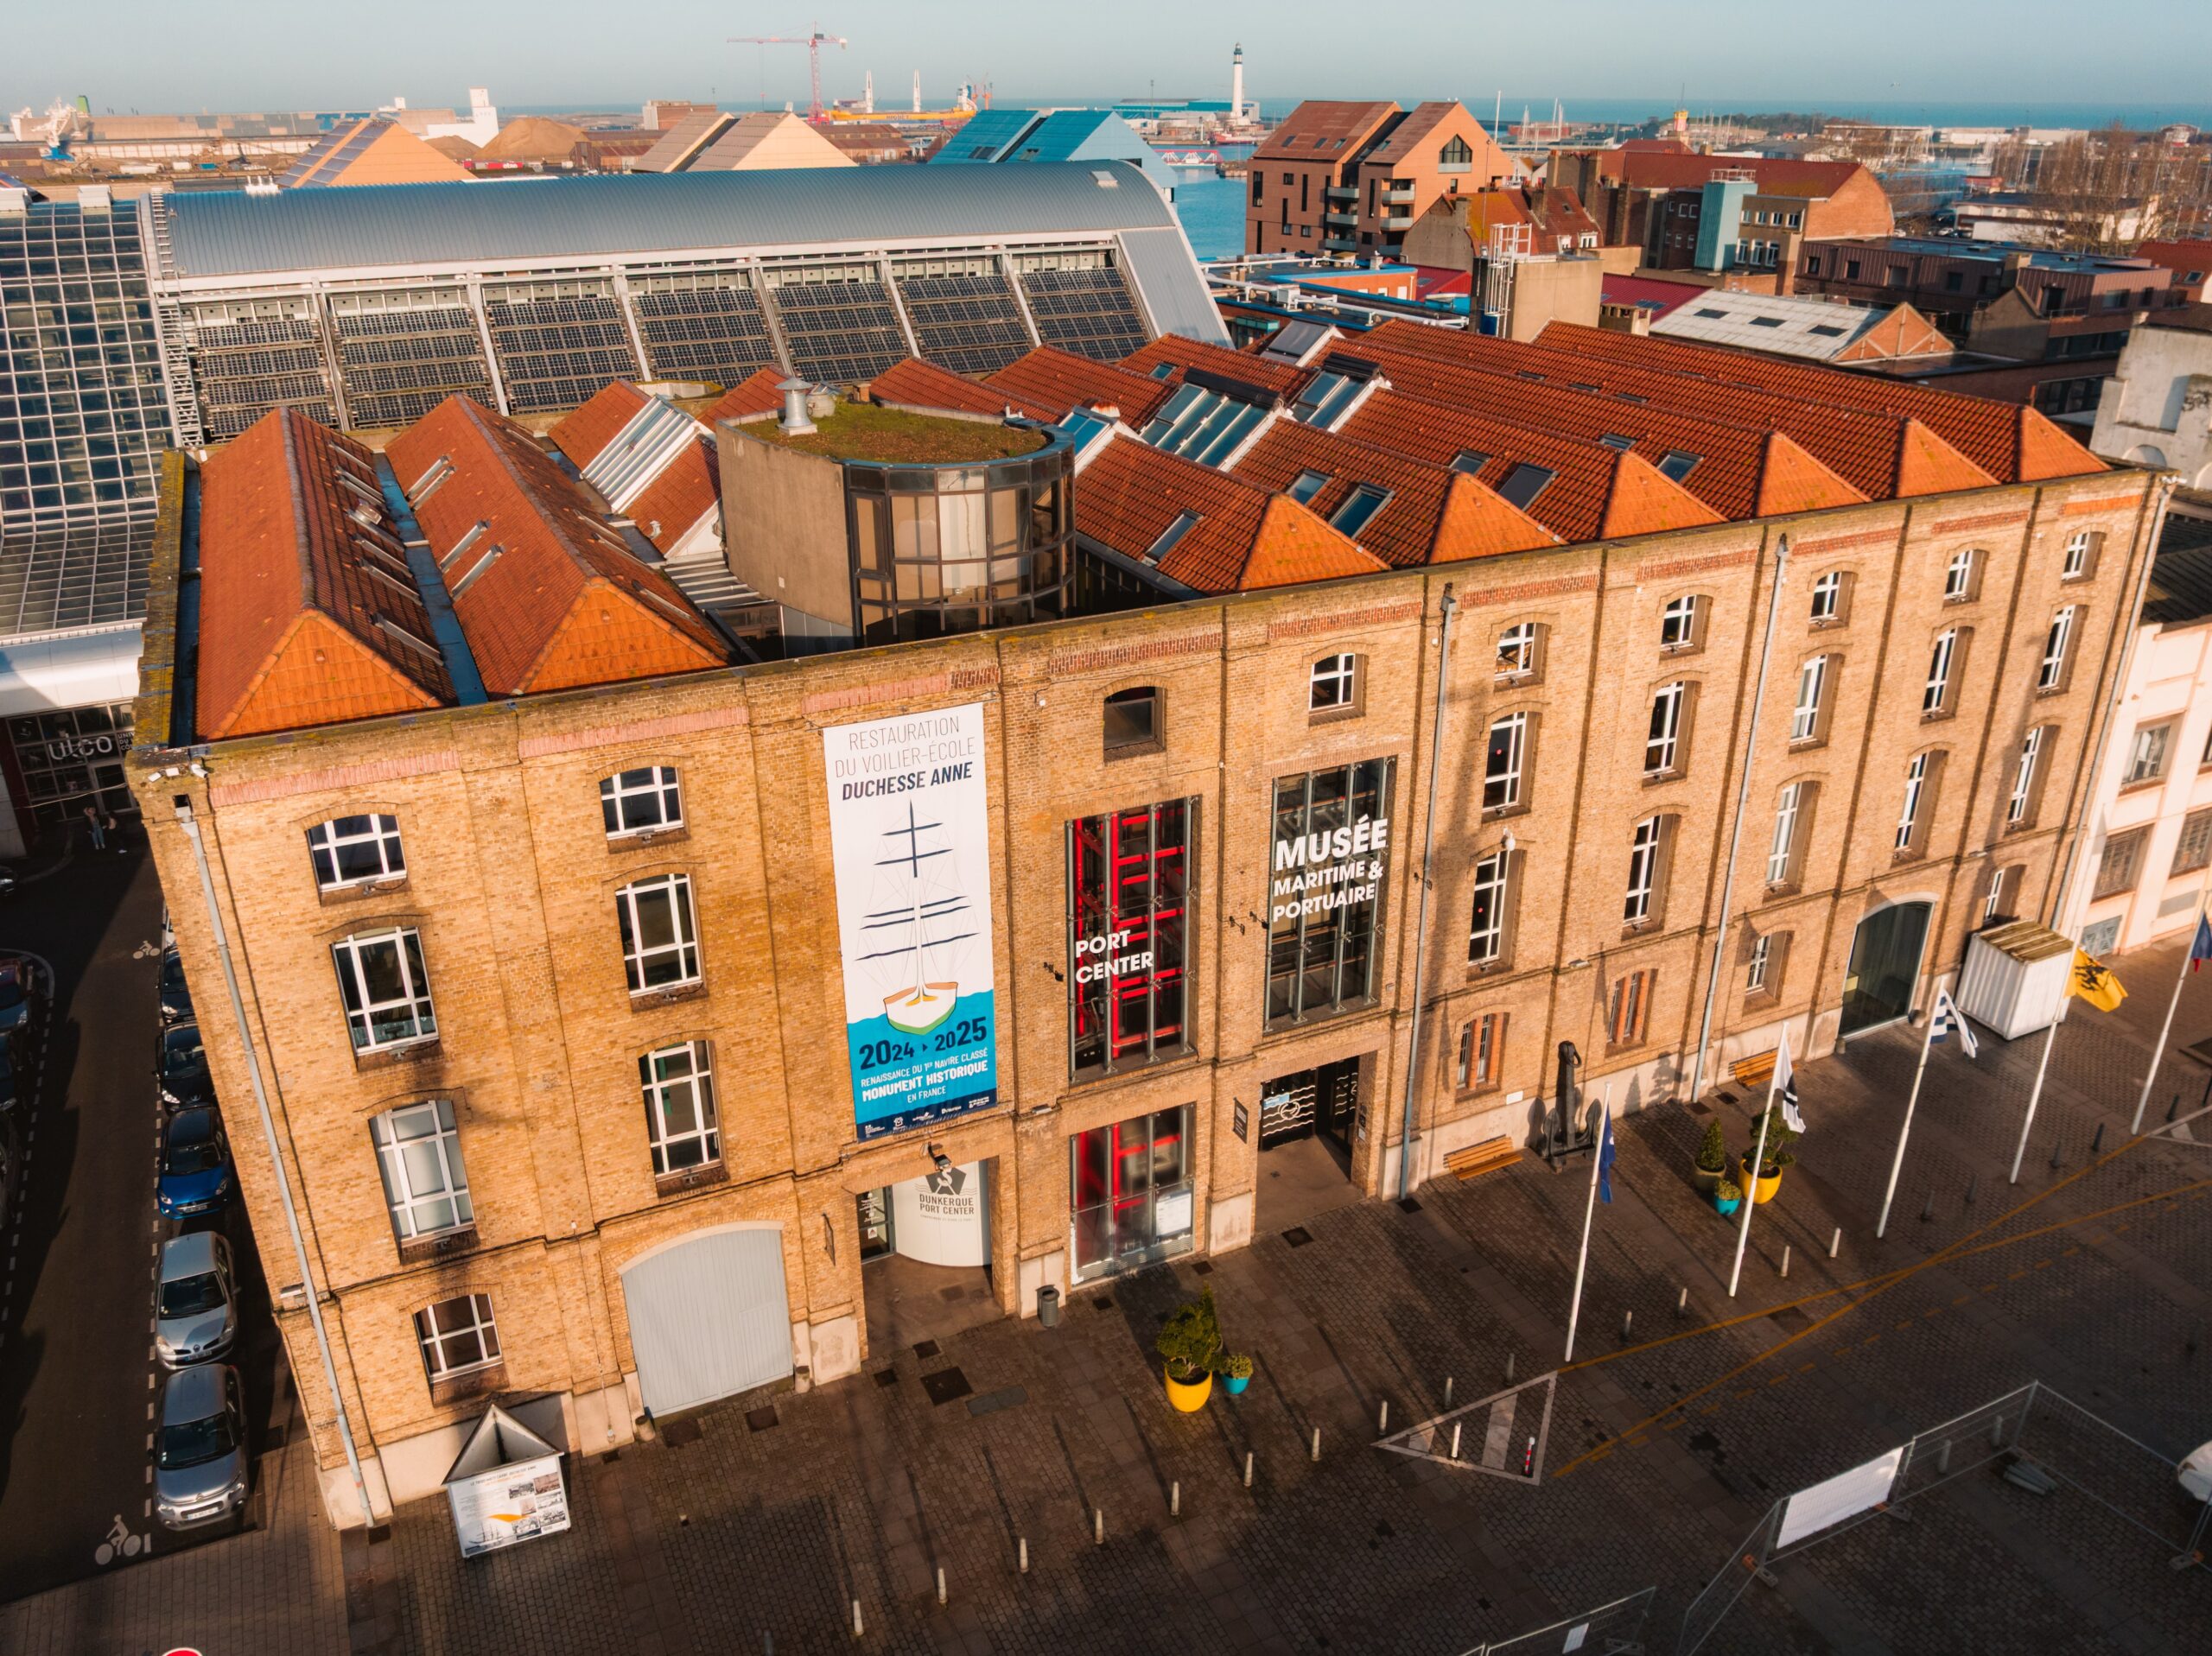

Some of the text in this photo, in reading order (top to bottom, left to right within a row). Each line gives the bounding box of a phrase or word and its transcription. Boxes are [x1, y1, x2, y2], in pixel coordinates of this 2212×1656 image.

[849, 715, 960, 751] RESTAURATION
[835, 736, 976, 777] DU VOILIER-ÉCOLE
[842, 761, 973, 801] DUCHESSE ANNE
[1275, 814, 1389, 872] MUSÉE
[1274, 860, 1383, 897] MARITIME &
[1273, 883, 1376, 923] PORTUAIRE
[1076, 930, 1131, 958] PORT
[1076, 951, 1154, 984] CENTER
[859, 1016, 987, 1070] 2024 2025
[861, 1068, 910, 1088] RENAISSANCE
[912, 1065, 922, 1074] DU
[935, 1055, 959, 1069] NAVIRE
[961, 1047, 988, 1062] CLASSÉ
[862, 1060, 988, 1101] MONUMENT HISTORIQUE
[907, 1085, 946, 1103] EN FRANCE
[919, 1194, 974, 1206] DUNKERQUE
[919, 1203, 975, 1215] PORT CENTER
